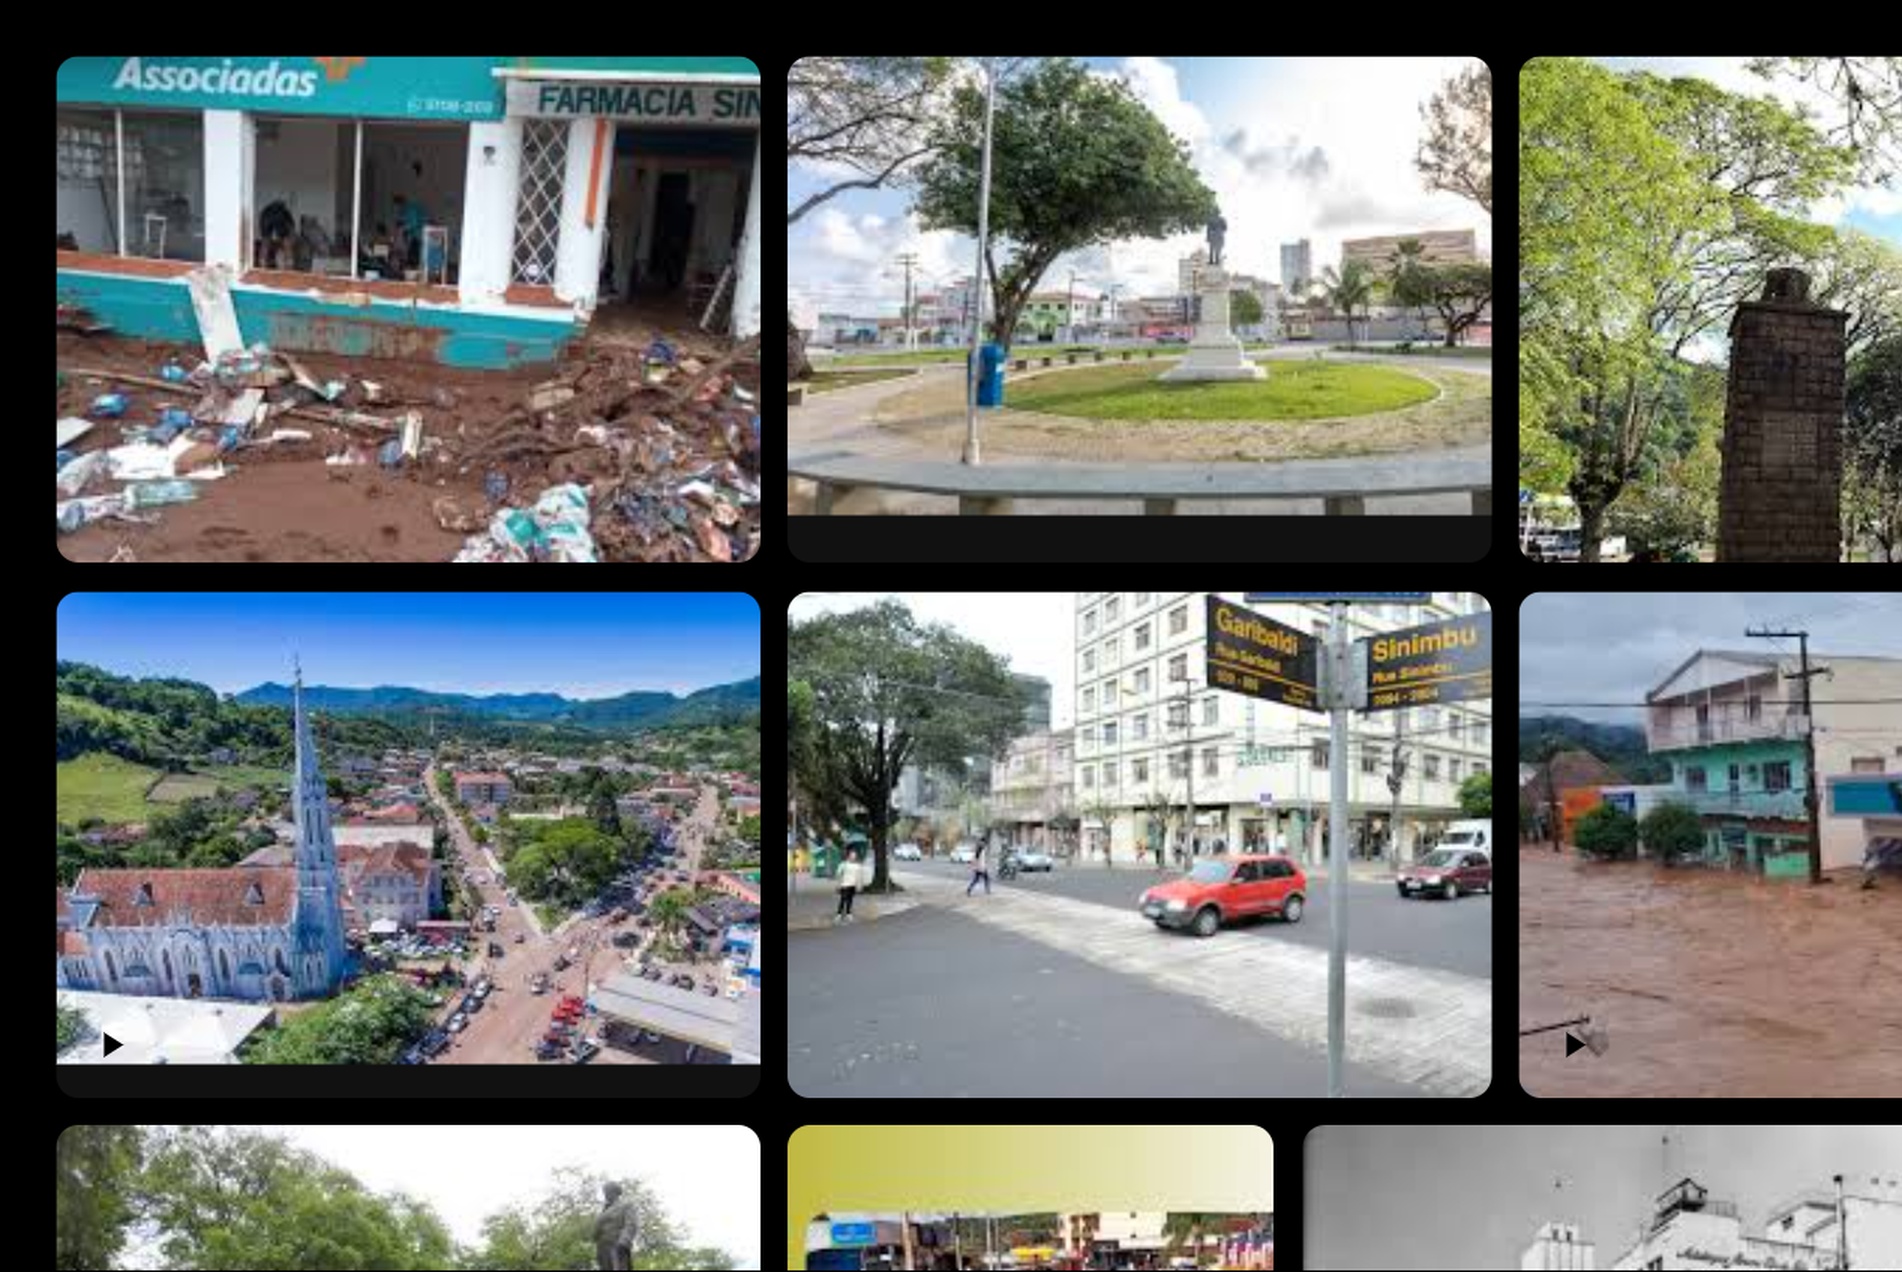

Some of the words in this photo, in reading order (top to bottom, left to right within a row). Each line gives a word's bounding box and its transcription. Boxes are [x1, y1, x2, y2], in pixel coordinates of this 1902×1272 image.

[114, 57, 317, 97] Associadas
[539, 86, 696, 117] FARMACIA
[1215, 607, 1298, 657] Garibaldi
[1372, 627, 1477, 663] Sinimbu
